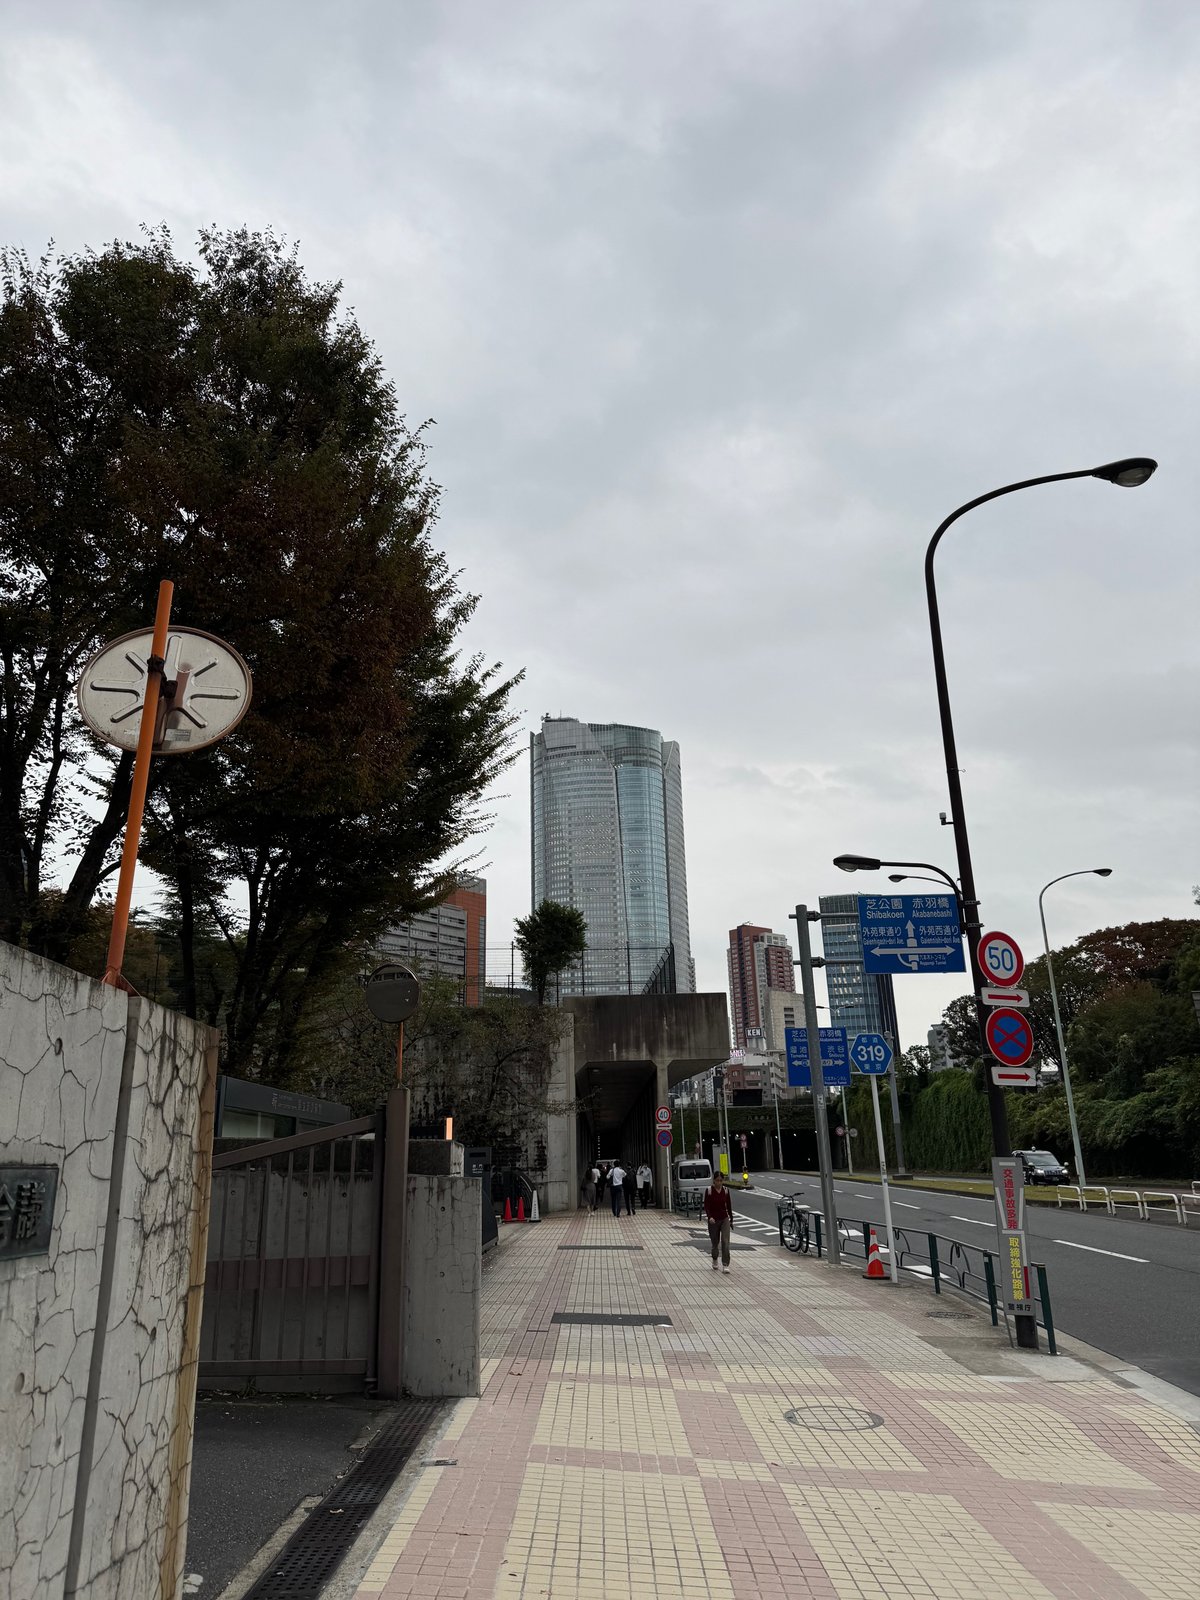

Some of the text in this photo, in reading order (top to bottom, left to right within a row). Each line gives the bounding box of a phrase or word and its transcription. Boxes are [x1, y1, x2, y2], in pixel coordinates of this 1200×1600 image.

[865, 898, 903, 910] 芝公園
[912, 897, 950, 909] 赤羽橋
[866, 910, 905, 919] Shibakoen
[912, 909, 953, 918] Akabanebashi
[862, 926, 902, 937] 外苑東通り
[919, 925, 959, 936] 外苑西通り
[988, 945, 1014, 972] 50
[747, 1028, 761, 1036] KEN
[857, 1045, 885, 1062] 319
[659, 1110, 668, 1119] 40
[1002, 1168, 1018, 1229] 交通事故多発
[1008, 1237, 1024, 1300] 取締強化路線
